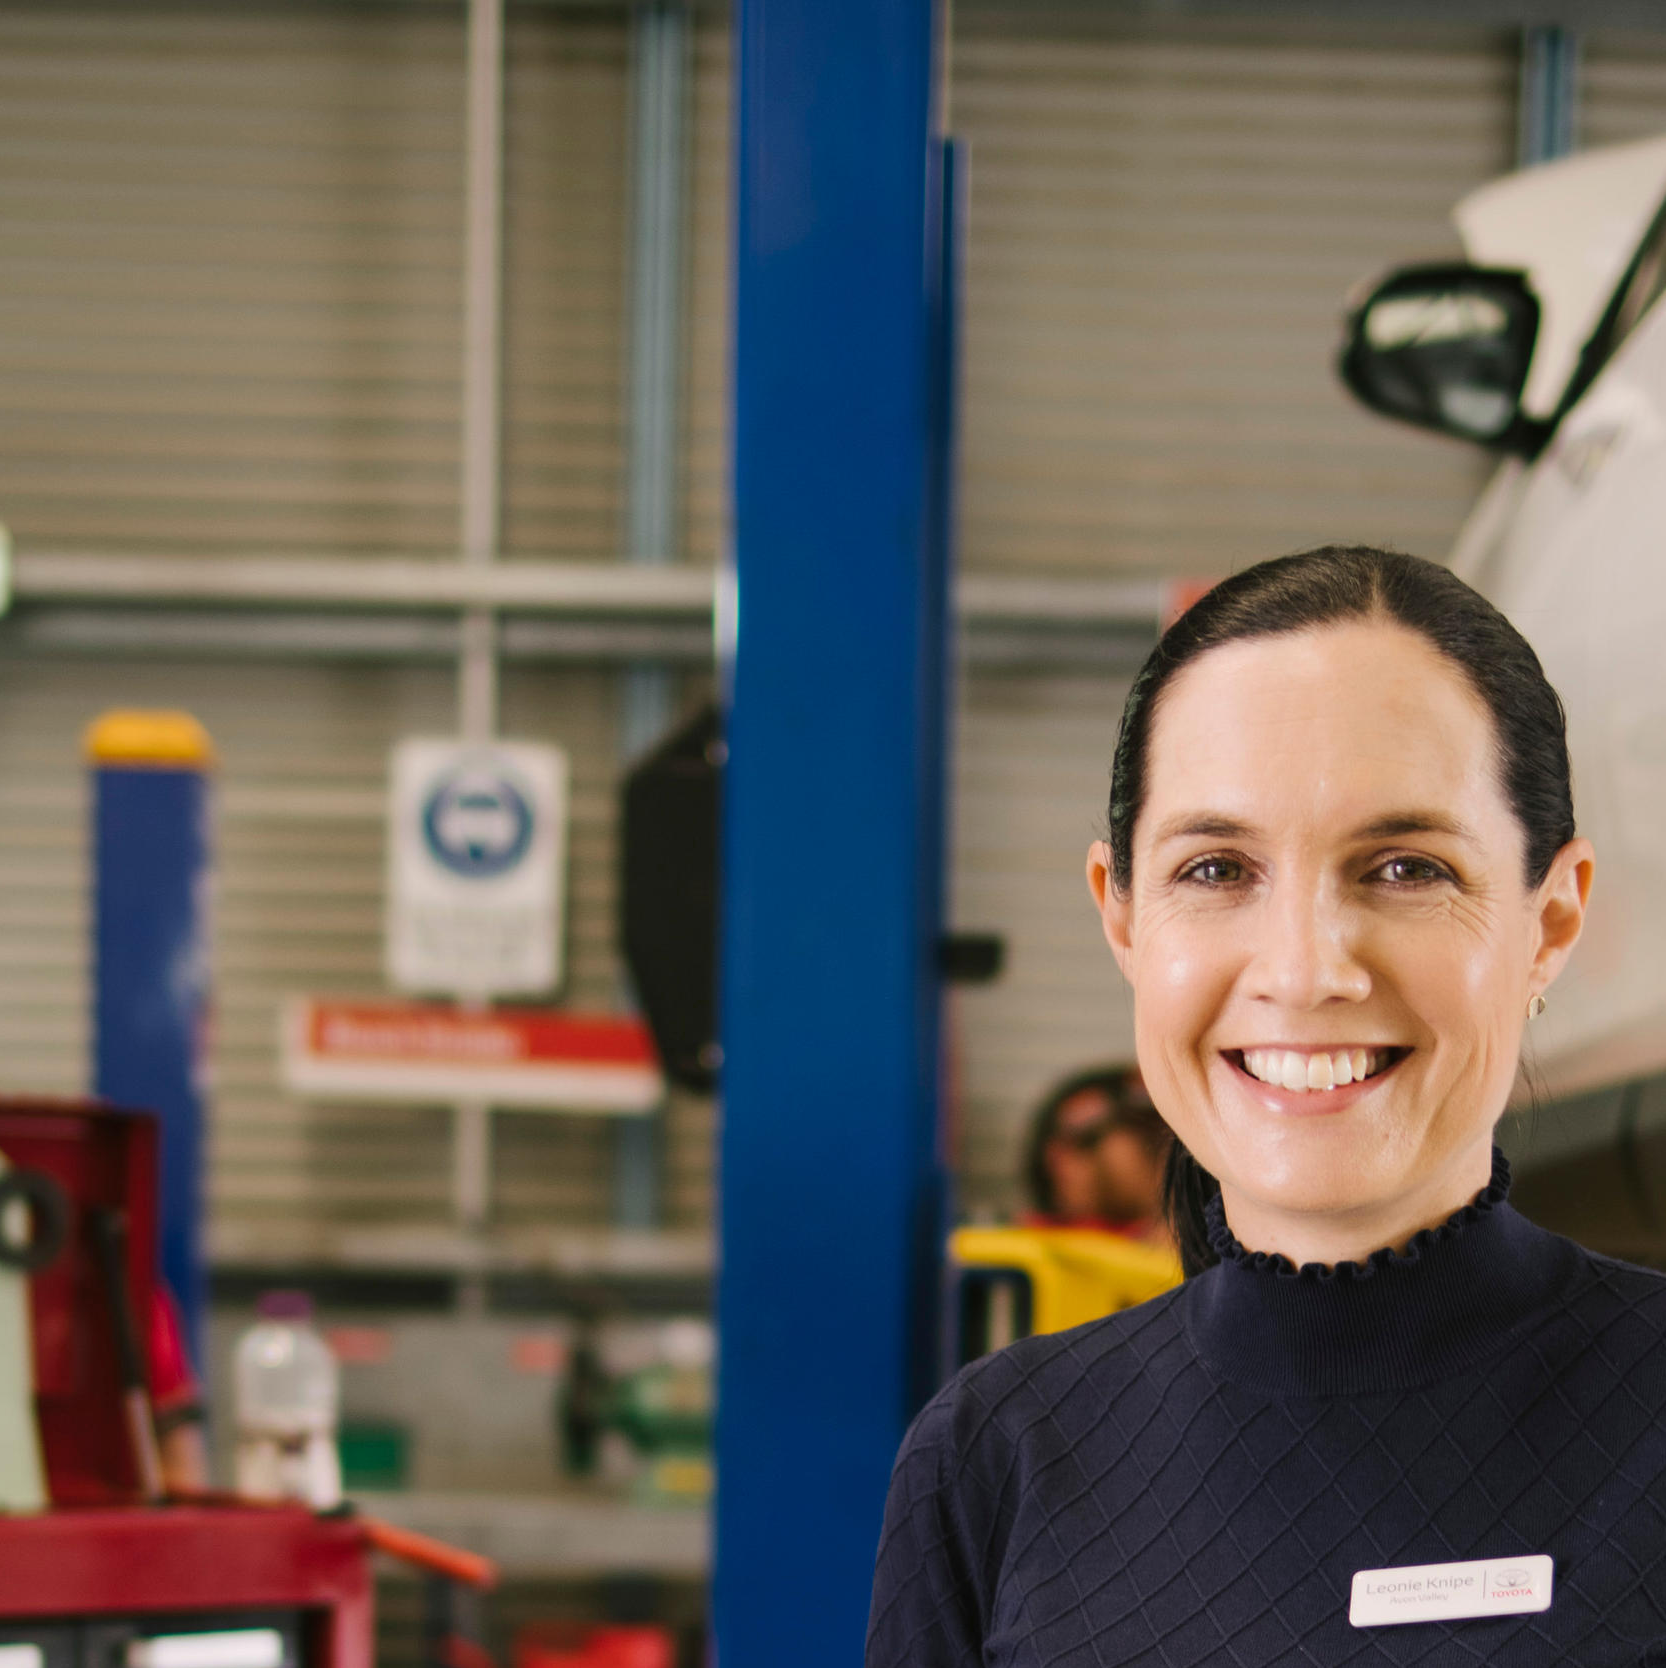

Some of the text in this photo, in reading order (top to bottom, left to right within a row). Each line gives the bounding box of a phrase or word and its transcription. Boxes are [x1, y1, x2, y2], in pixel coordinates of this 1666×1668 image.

[1366, 1575, 1475, 1595] Leonie Knipe
[1389, 1592, 1449, 1605] Avon Valley
[1491, 1588, 1533, 1599] TOYOTA
